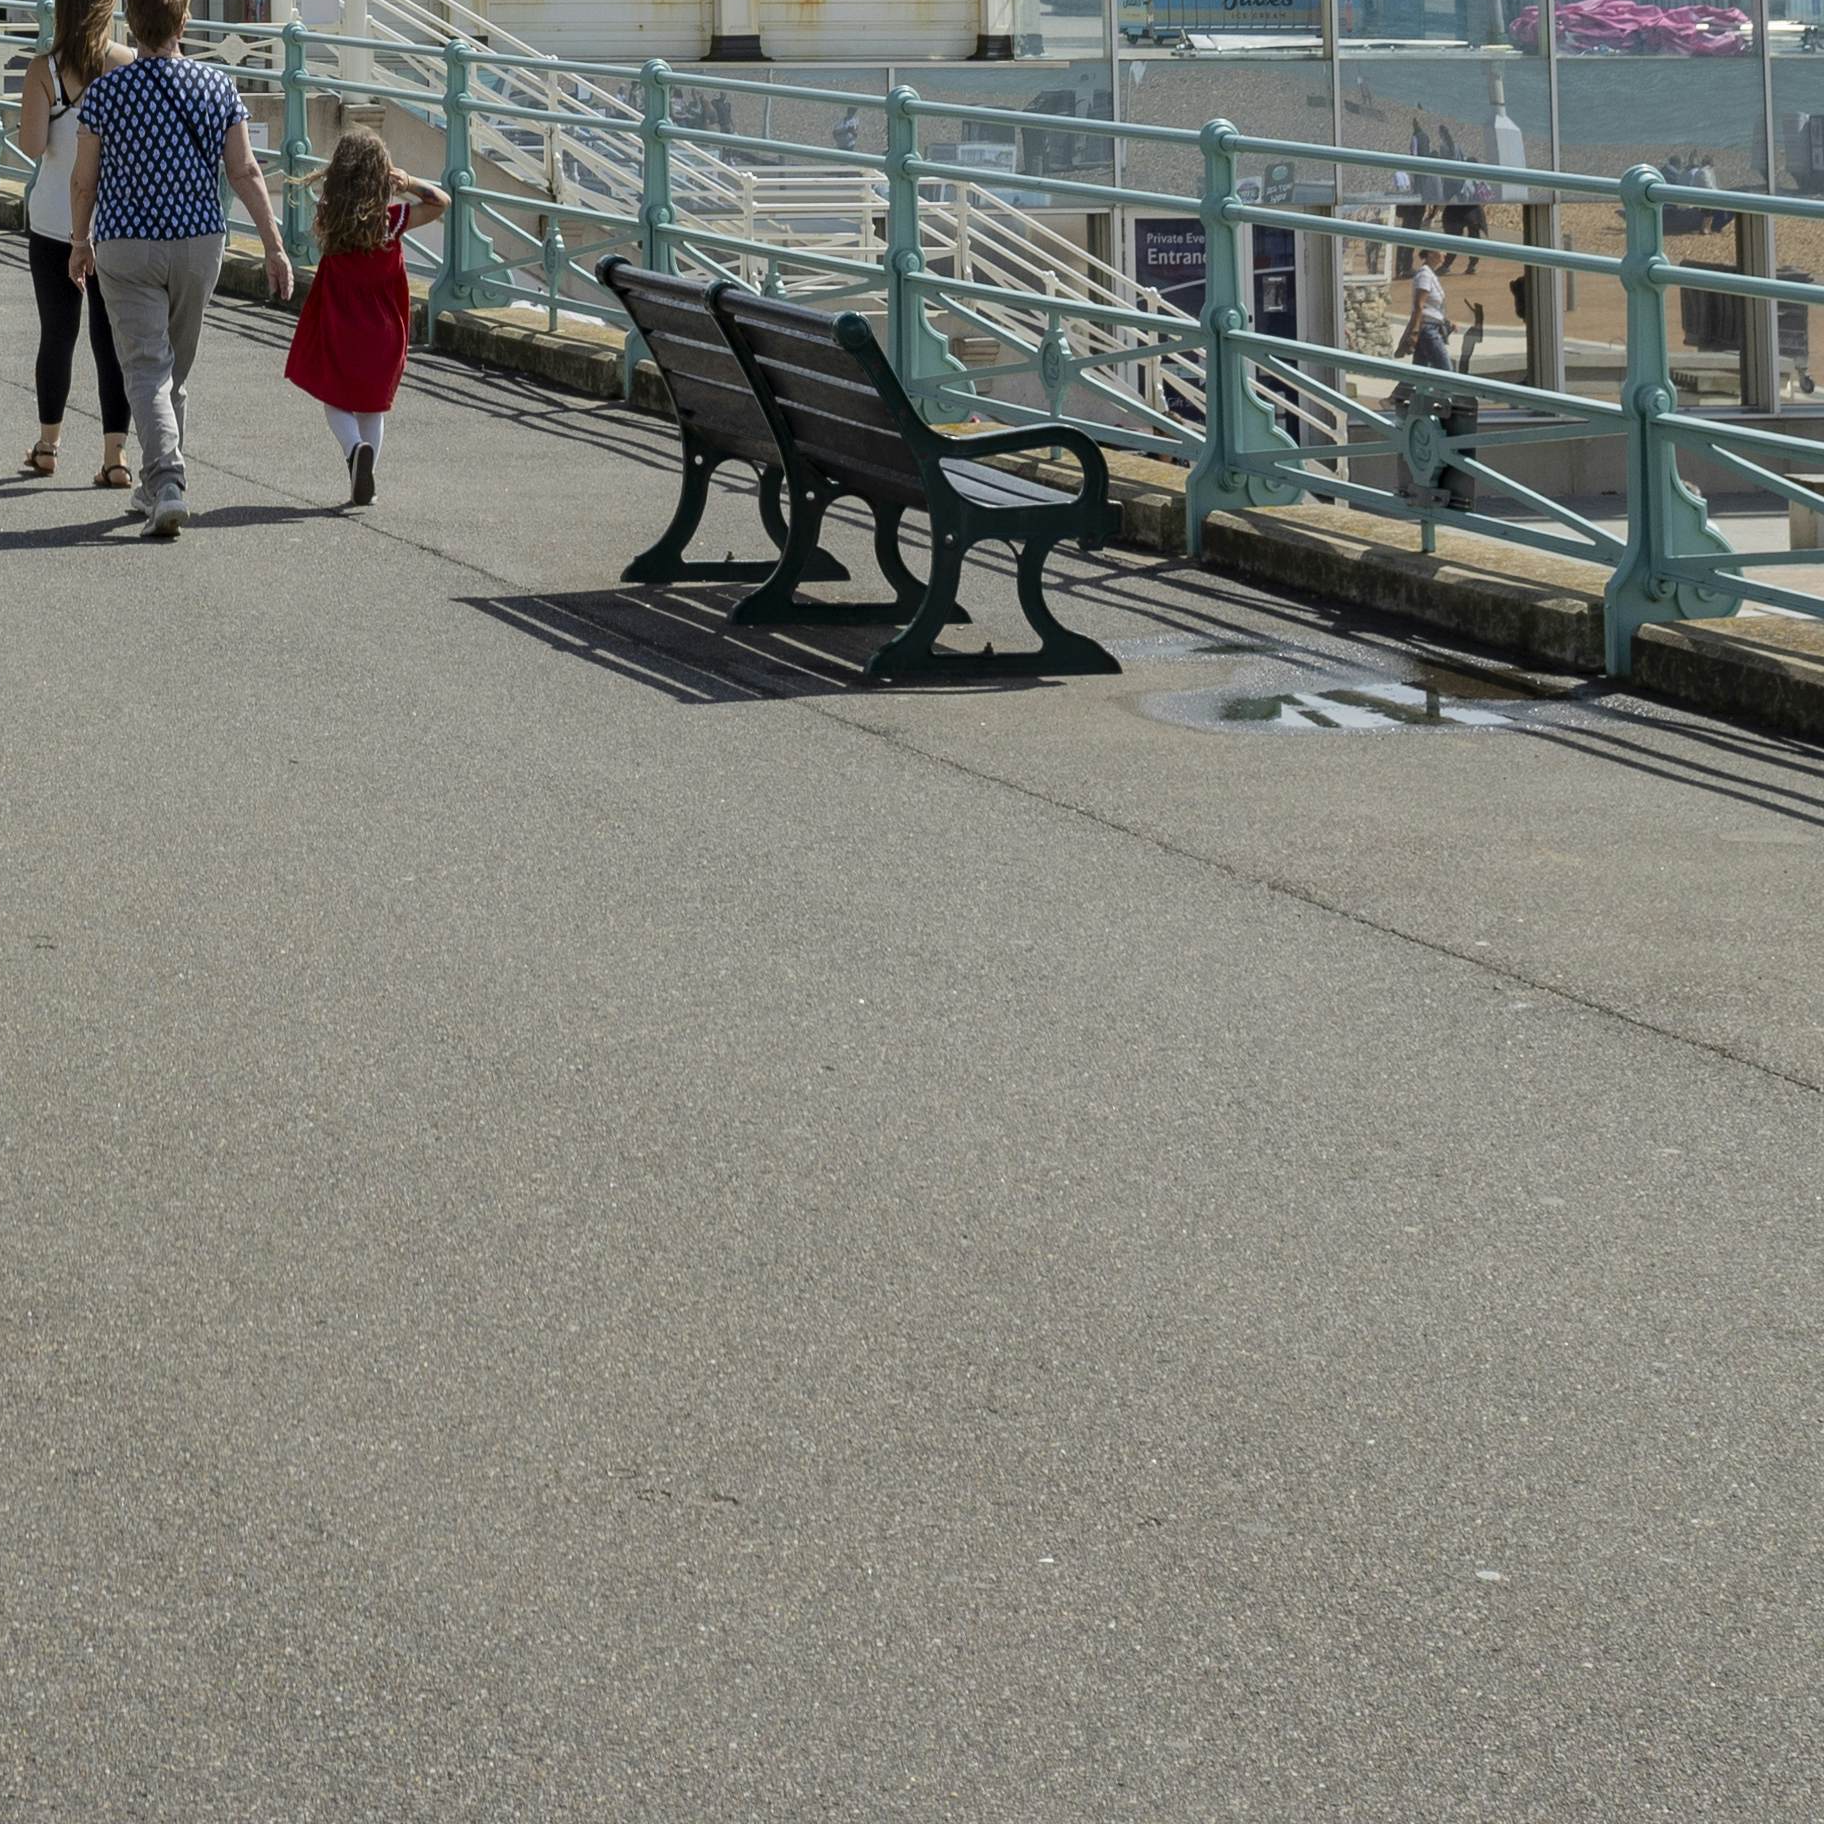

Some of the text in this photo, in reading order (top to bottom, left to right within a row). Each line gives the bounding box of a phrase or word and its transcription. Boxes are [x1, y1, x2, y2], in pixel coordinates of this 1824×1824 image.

[1146, 232, 1205, 244] Private Eve
[1148, 248, 1207, 265] Entran
